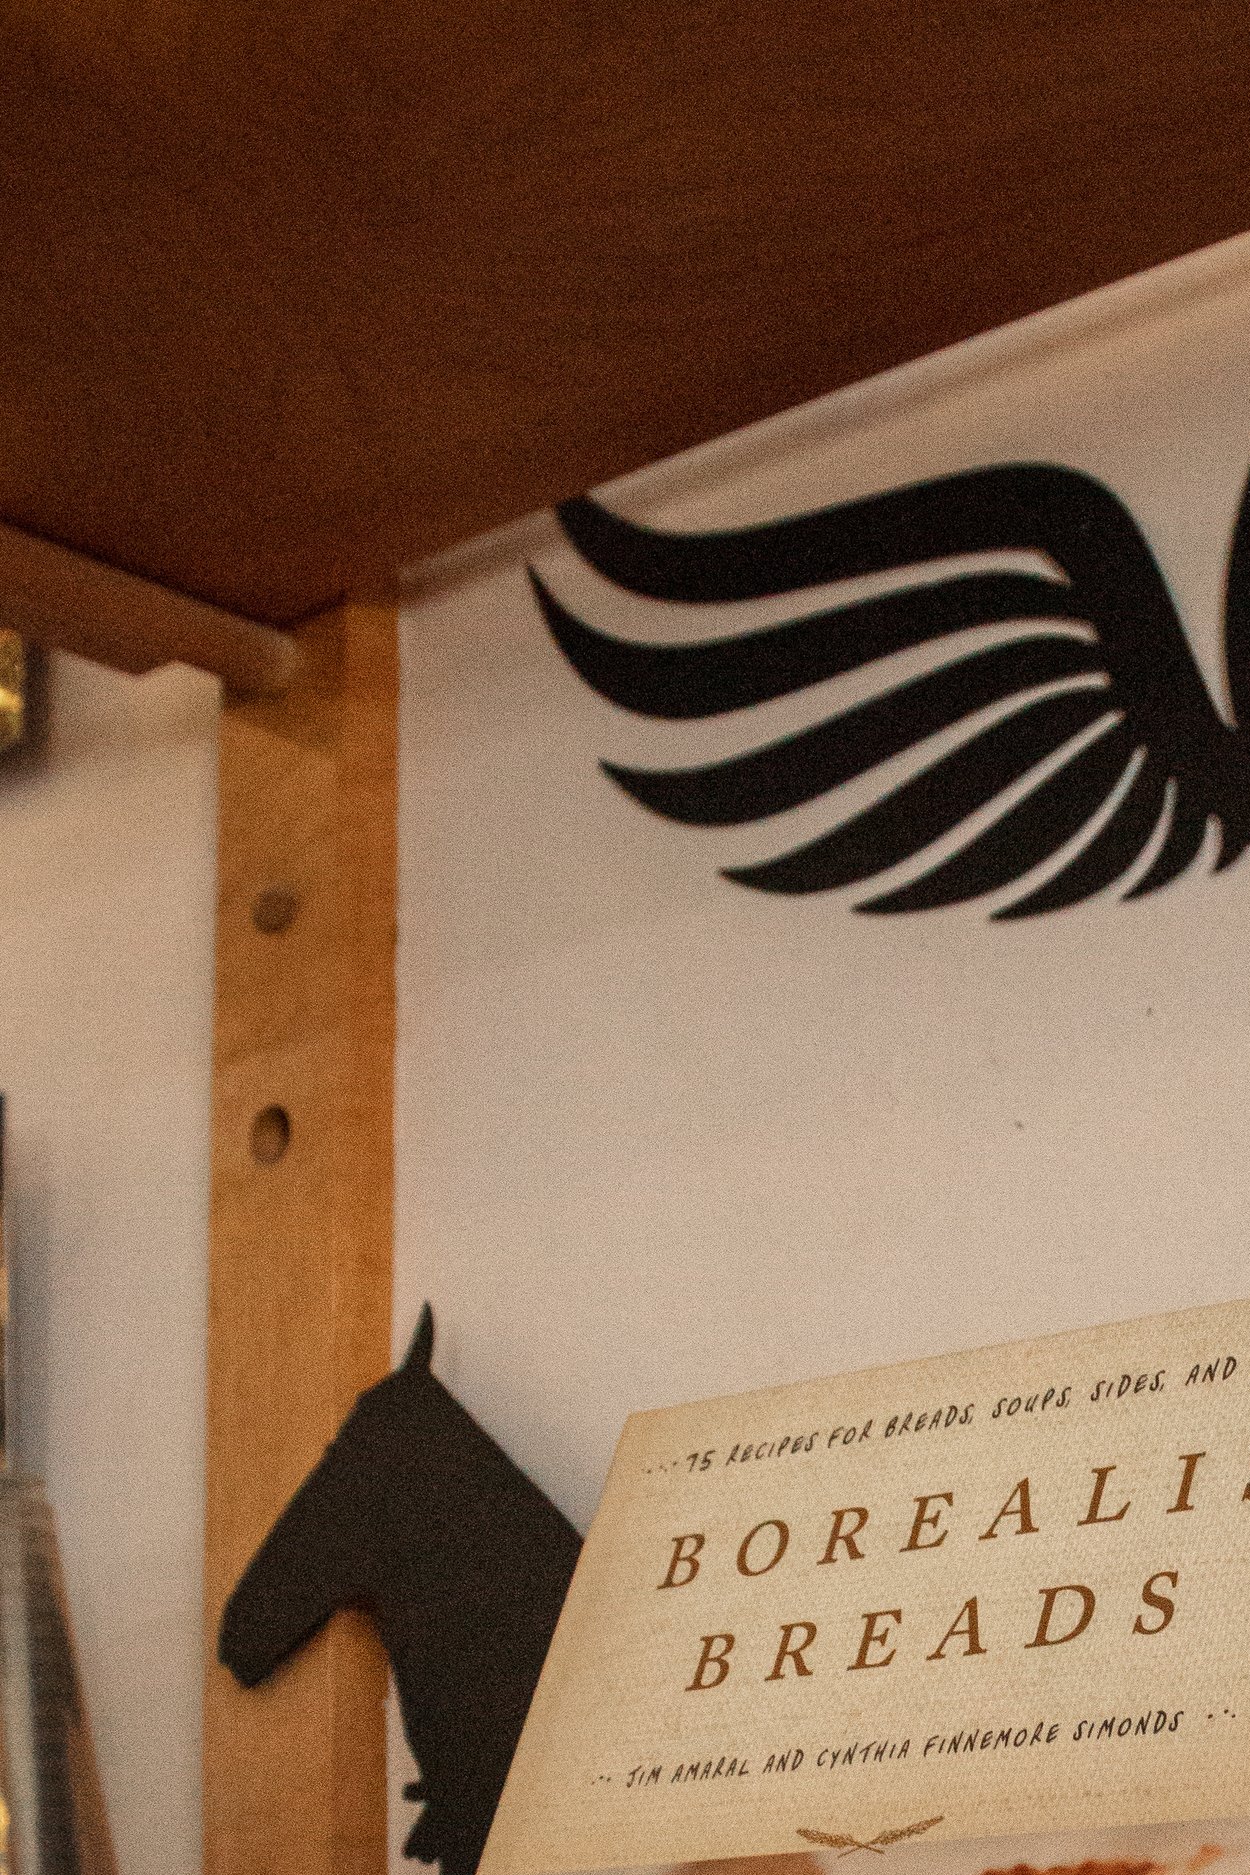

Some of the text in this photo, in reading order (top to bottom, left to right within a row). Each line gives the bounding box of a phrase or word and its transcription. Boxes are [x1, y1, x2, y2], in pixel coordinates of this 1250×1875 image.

[687, 1450, 715, 1471] 75
[726, 1432, 819, 1466] RECIPES
[827, 1419, 873, 1448] FOR
[884, 1403, 975, 1439] BREADS,
[992, 1386, 1071, 1419] SOUPS,
[1090, 1370, 1165, 1401] SIDES,
[1185, 1356, 1238, 1387] AND
[685, 1570, 1179, 1692] BREADS
[626, 1710, 1184, 1788] JIM AMARAL AND CYNTHIA FINNEMORE SIMONDS
